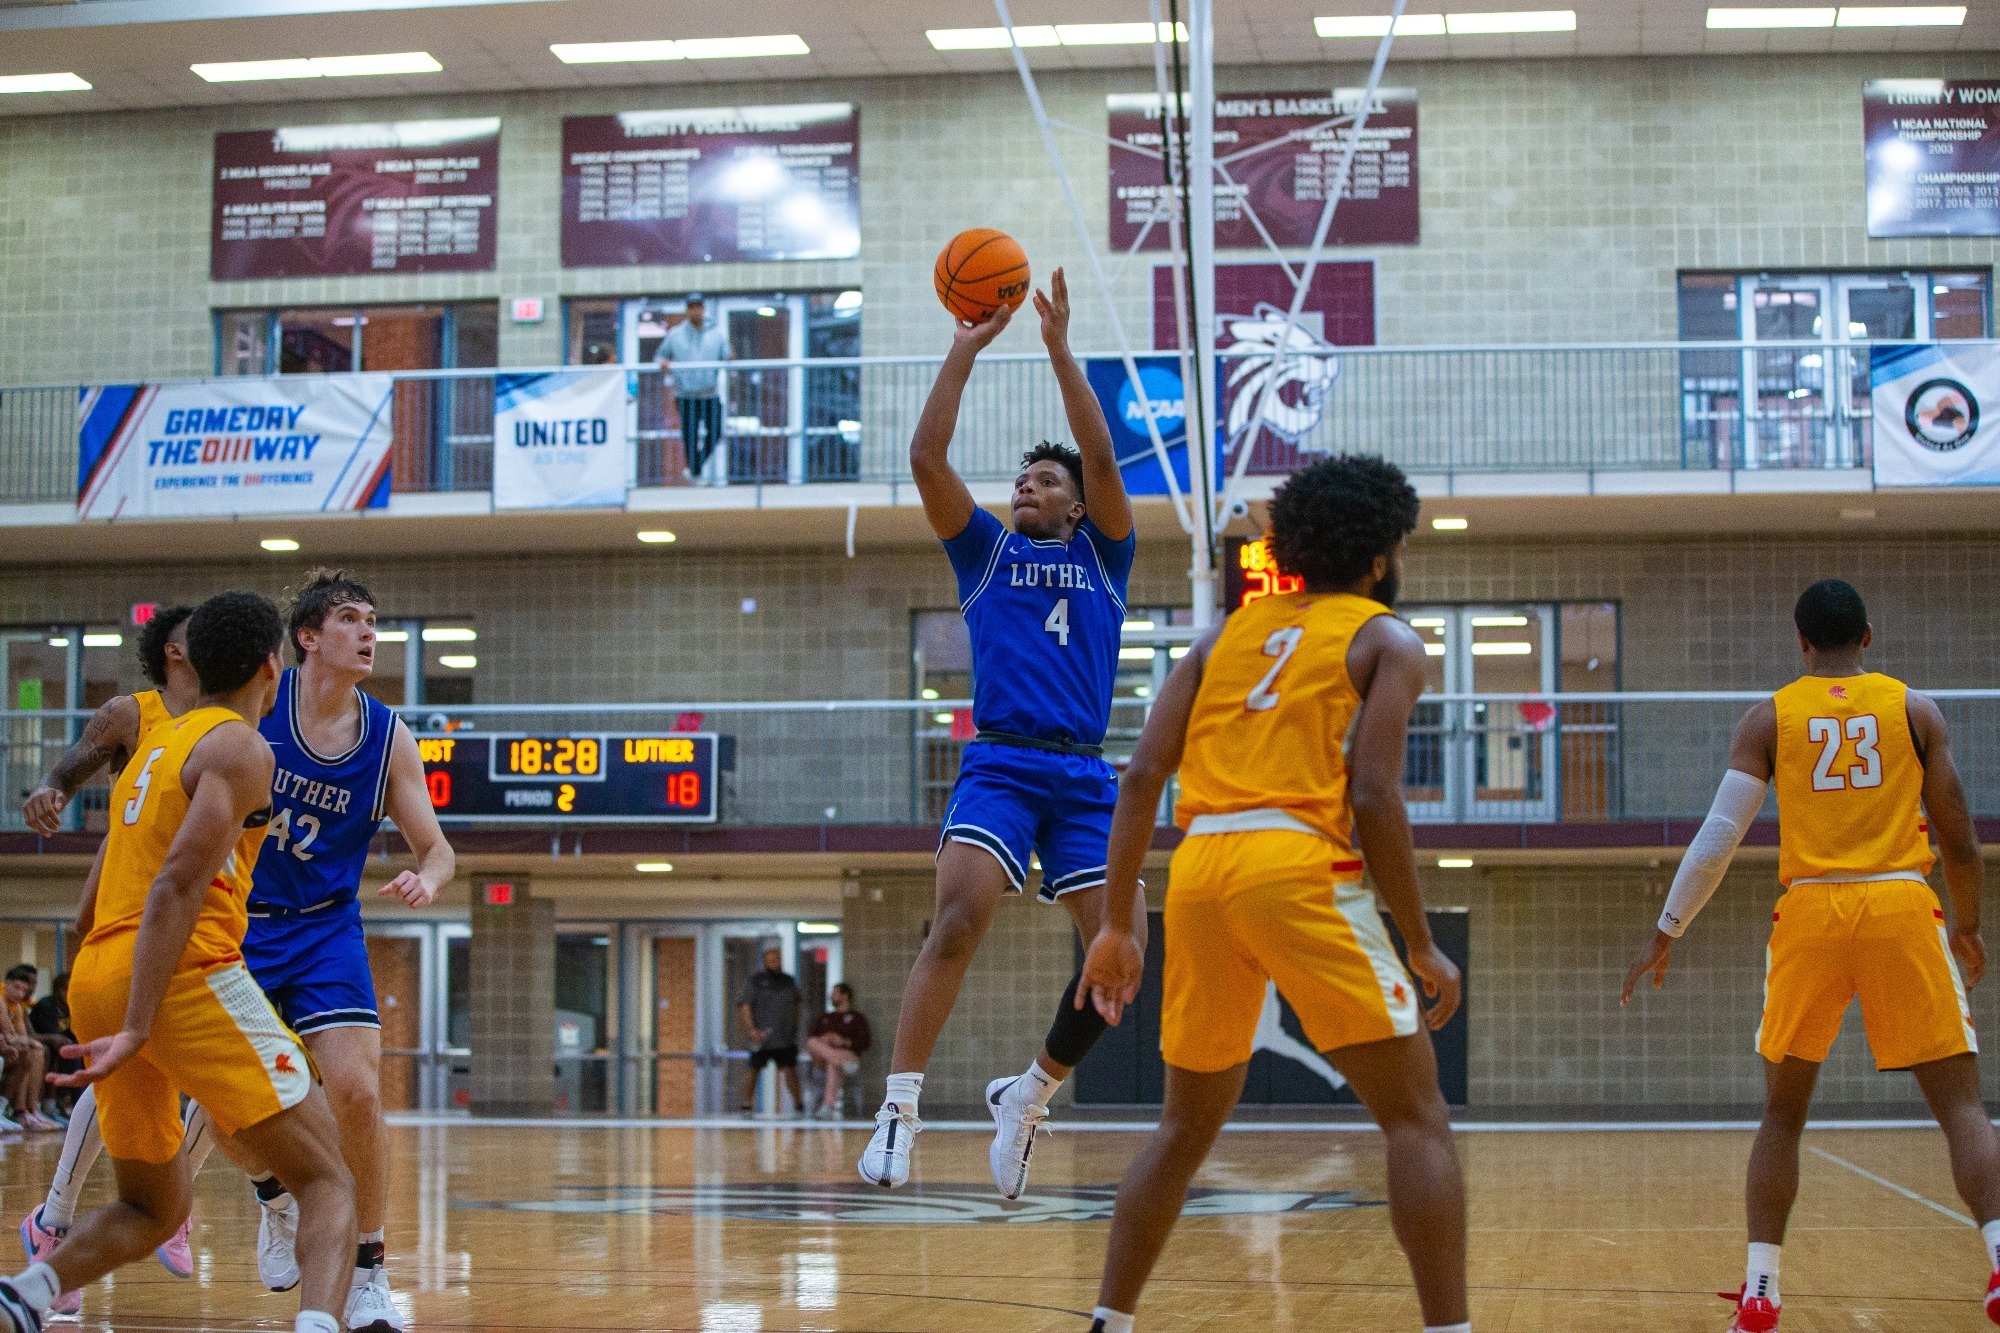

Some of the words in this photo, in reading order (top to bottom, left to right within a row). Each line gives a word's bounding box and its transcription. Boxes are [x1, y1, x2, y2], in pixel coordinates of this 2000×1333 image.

[1899, 129, 1983, 142] CHAMPIONSHIP
[1900, 118, 1932, 130] NCAA
[1933, 117, 1989, 130] NATIONAL
[164, 405, 306, 436] GAMEDAY
[515, 418, 608, 448] UNITED
[1044, 598, 1070, 646] 4
[1245, 625, 1306, 712] 2
[510, 738, 598, 775] 18:28
[624, 739, 695, 763] LUTHER
[1807, 713, 1884, 793] 23
[122, 745, 167, 827] 5
[273, 767, 352, 815] UTHER
[557, 783, 577, 813] 2
[666, 771, 701, 808] 18
[269, 807, 322, 862] 42
